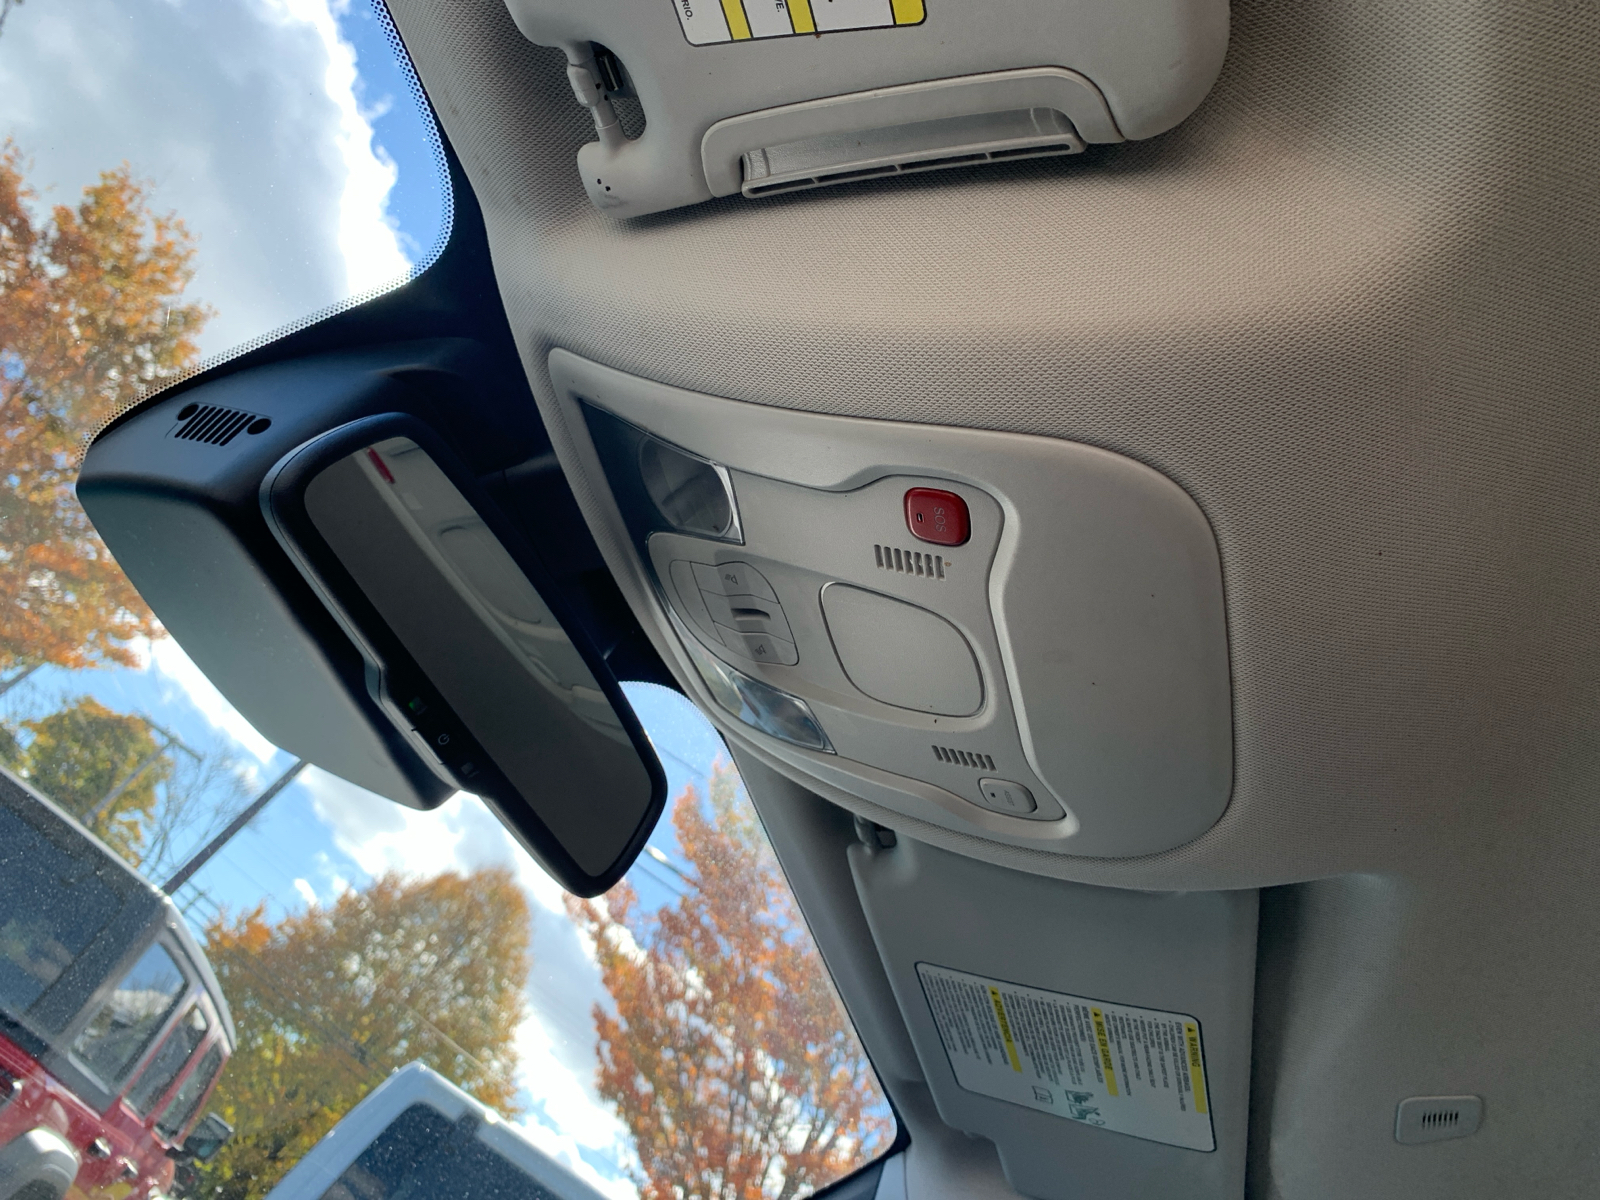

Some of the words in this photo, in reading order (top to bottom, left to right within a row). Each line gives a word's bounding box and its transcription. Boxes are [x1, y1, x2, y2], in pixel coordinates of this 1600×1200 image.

[934, 506, 947, 532] SOS
[994, 999, 1013, 1044] ADVERTENCIA
[1095, 1020, 1106, 1037] MISE
[1099, 1038, 1108, 1048] EN
[1189, 1036, 1200, 1068] WARNING
[1101, 1048, 1113, 1071] GARDE
